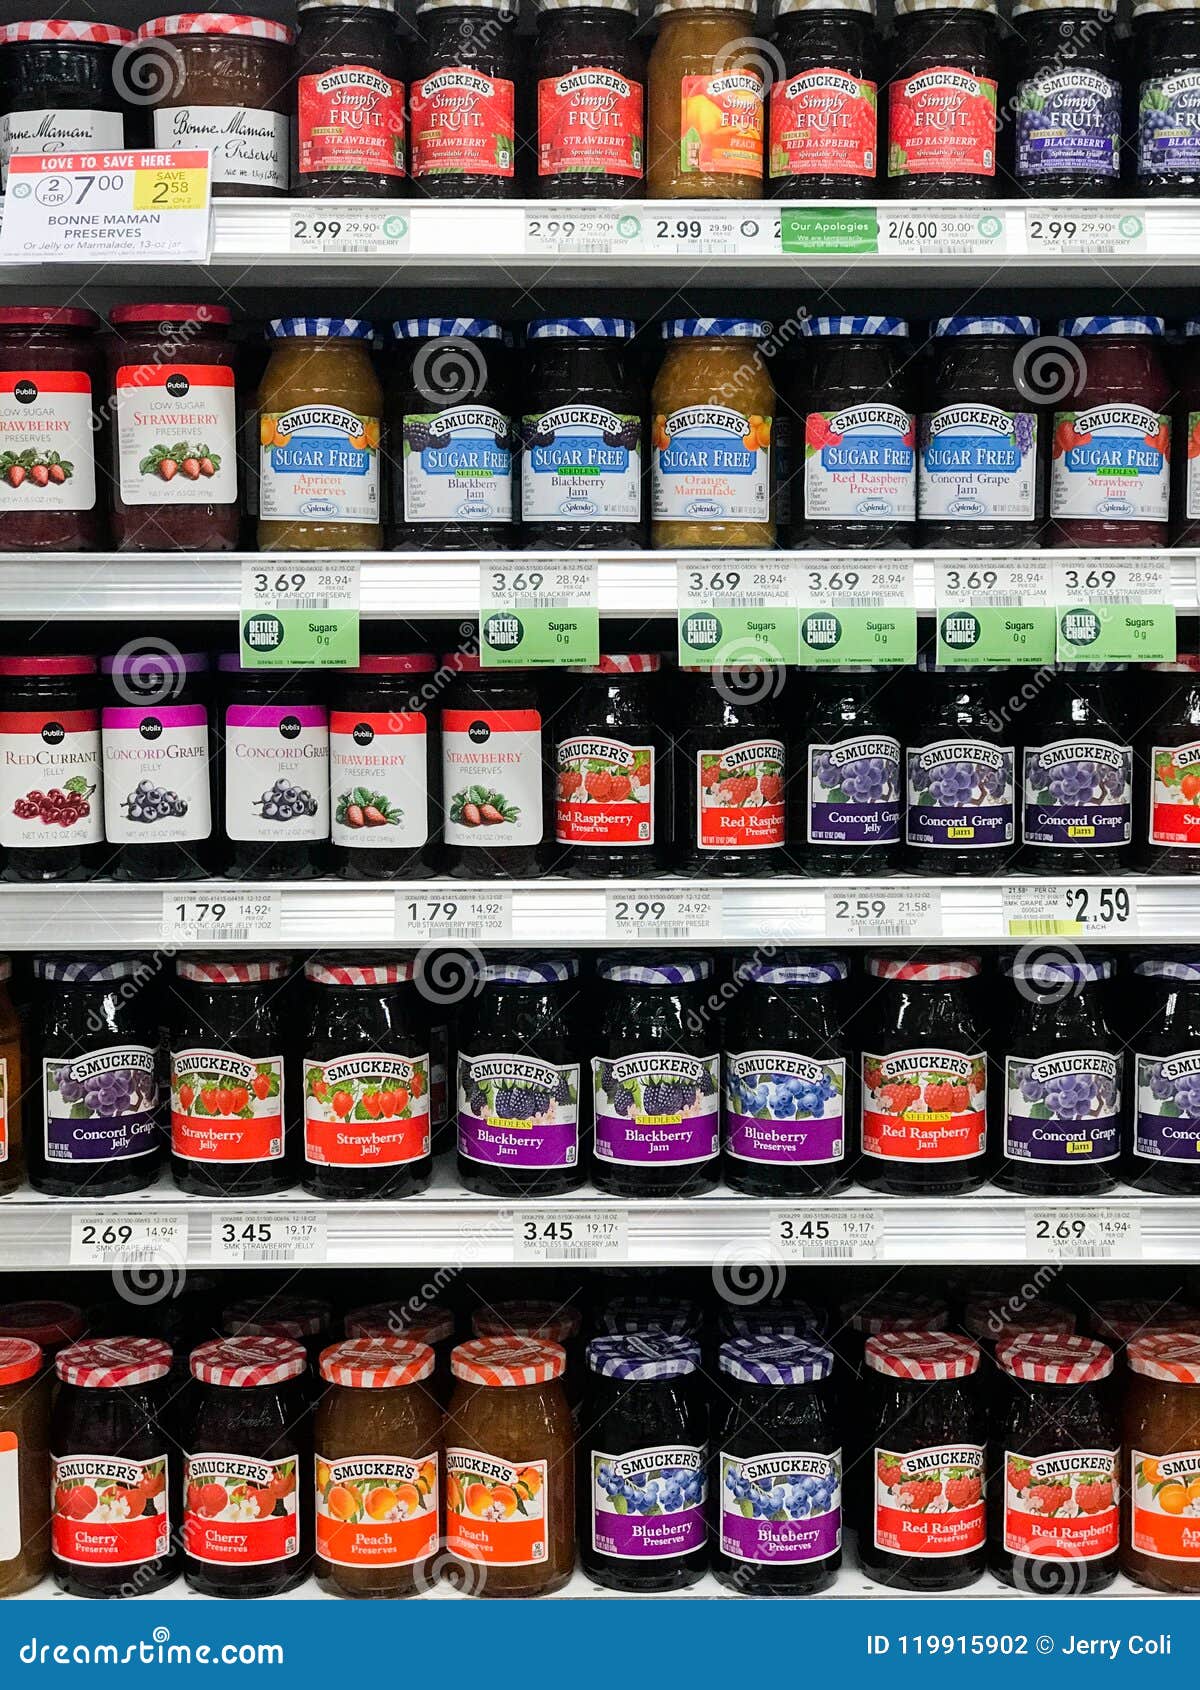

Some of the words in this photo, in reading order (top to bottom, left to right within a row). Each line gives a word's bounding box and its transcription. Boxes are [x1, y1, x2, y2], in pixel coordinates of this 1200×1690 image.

[321, 71, 389, 94] SMUCKER'S
[423, 73, 489, 95] SMUCKER'S
[560, 73, 628, 94] SMUCKER'S
[789, 77, 857, 95] SMUCKER'S
[908, 75, 977, 94] SMUCKER'S
[1042, 76, 1110, 96] SMUCKER'S
[332, 91, 380, 111] Simply
[432, 92, 480, 112] Simply
[570, 91, 619, 111] Simply
[800, 95, 846, 113] Simply
[918, 94, 967, 110] Simply
[1053, 95, 1100, 111] Simply
[173, 110, 219, 135] Bonne
[324, 136, 386, 147] STRAWBERRY
[426, 137, 487, 148] STRAWBERRY
[41, 159, 73, 170] LOVE
[81, 158, 96, 168] TO
[104, 156, 134, 167] SAVE
[141, 155, 175, 166] HERE.
[157, 172, 185, 180] SAVE
[48, 179, 59, 191] 2
[43, 194, 63, 202] FOR
[49, 216, 99, 225] BONNE
[103, 215, 160, 224] MAMAN
[791, 222, 816, 230] Our
[820, 222, 869, 233] Apologies
[64, 229, 141, 238] PRESERVES
[294, 221, 341, 239] 2.99
[528, 221, 575, 238] 2.99
[656, 221, 701, 238] 2.99
[889, 221, 937, 238] 2/6.00
[1030, 221, 1076, 238] 2.99
[39, 242, 60, 250] Jelly
[15, 388, 36, 396] Publix
[167, 382, 188, 390] Publix
[150, 401, 171, 409] LOW
[134, 412, 218, 425] STRAWBERRY
[281, 411, 361, 436] SMUCKER'S
[435, 413, 504, 433] SMUCKER'S
[541, 412, 619, 436] SMUCKER'S
[669, 413, 745, 434] SMUCKER'S
[934, 413, 1007, 430] SMUCKER'S
[1079, 413, 1156, 432] SMUCKER'S
[276, 450, 324, 467] SUGAR
[428, 451, 476, 467] SUGAR
[480, 452, 509, 468] FREE
[536, 449, 583, 466] SUGAR
[588, 450, 623, 466] FREE
[663, 450, 707, 467] SUGAR
[715, 450, 750, 467] FREE
[829, 448, 878, 465] SUGAR
[928, 448, 971, 465] SUGAR
[977, 448, 1014, 465] FREE
[1071, 449, 1122, 465] SUGAR
[1127, 450, 1159, 467] FREE
[299, 474, 341, 490] Apricot
[551, 476, 605, 491] Blackberry
[977, 474, 1010, 486] Grape
[292, 484, 346, 497] Preserves
[466, 489, 484, 500] Jam
[569, 488, 588, 499] Jam
[254, 574, 305, 592] 3.69
[492, 573, 544, 591] 3.69
[689, 572, 741, 590] 3.69
[808, 572, 859, 590] 3.69
[946, 572, 998, 589] 3.69
[1065, 571, 1116, 588] 3.69
[249, 621, 278, 632] BETTER
[309, 623, 337, 633] Sugars
[489, 620, 518, 632] BETTER
[548, 622, 577, 631] Sugars
[807, 620, 836, 630] BETTER
[867, 622, 895, 631] Sugars
[1005, 621, 1034, 630] Sugars
[249, 634, 279, 645] CHOICE
[489, 633, 519, 644] CHOICE
[807, 632, 836, 643] CHOICE
[141, 725, 161, 733] Publix
[446, 750, 522, 763] STRAWBERRY
[560, 744, 629, 767] SMUCKER'S
[924, 748, 999, 766] SMUCKER'S
[1044, 748, 1119, 765] SMUCKER'S
[574, 811, 633, 827] Raspberry
[920, 815, 967, 826] Concord
[1092, 815, 1122, 827] Grape
[864, 824, 881, 833] Jelly
[175, 904, 226, 921] 1.79
[407, 903, 458, 920] 1.79
[615, 902, 666, 920] 2.99
[835, 901, 886, 918] 2.59
[78, 1054, 153, 1077] SMUCKER'S
[176, 1058, 252, 1077] SMUCKER'S
[328, 1062, 410, 1080] SMUCKER'S
[617, 1061, 698, 1077] SMUCKER'S
[738, 1061, 817, 1079] SMUCKER'S
[887, 1056, 969, 1077] SMUCKER'S
[1038, 1059, 1113, 1077] SMUCKER'S
[474, 1067, 554, 1084] SMUCKER'S
[73, 1127, 126, 1140] Concord
[181, 1124, 243, 1143] Strawberry
[336, 1132, 404, 1145] Strawberry
[478, 1130, 544, 1149] Blackberry
[625, 1129, 693, 1142] Blackberry
[745, 1127, 807, 1144] Blueberry
[883, 1125, 906, 1139] Red
[1032, 1130, 1086, 1141] Concord
[111, 1138, 130, 1150] Jelly
[200, 1140, 218, 1151] Jelly
[360, 1146, 381, 1155] Jelly
[82, 1226, 132, 1244] 2.69
[222, 1225, 271, 1242] 3.45
[523, 1223, 573, 1240] 3.45
[780, 1221, 829, 1239] 3.45
[1036, 1220, 1086, 1238] 2.69
[622, 1454, 698, 1474] SMUCKER'S
[749, 1460, 826, 1479] SMUCKER'S
[906, 1452, 981, 1472] SMUCKER'S
[1037, 1458, 1111, 1476] SMUCKER'S
[60, 1464, 137, 1480] SMUCKER'S
[191, 1462, 267, 1480] SMUCKER'S
[334, 1464, 414, 1480] SMUCKER'S
[459, 1526, 489, 1541] Peach
[632, 1522, 693, 1538] Blueberry
[903, 1521, 929, 1533] Red
[932, 1518, 983, 1534] Raspberry
[1031, 1525, 1058, 1538] Red
[1060, 1522, 1112, 1540] Raspberry
[75, 1532, 118, 1546] Cherry
[205, 1530, 247, 1545] Cherry
[643, 1535, 684, 1546] Preserves
[758, 1529, 820, 1542] Blueberry
[769, 1541, 811, 1552] Preserves
